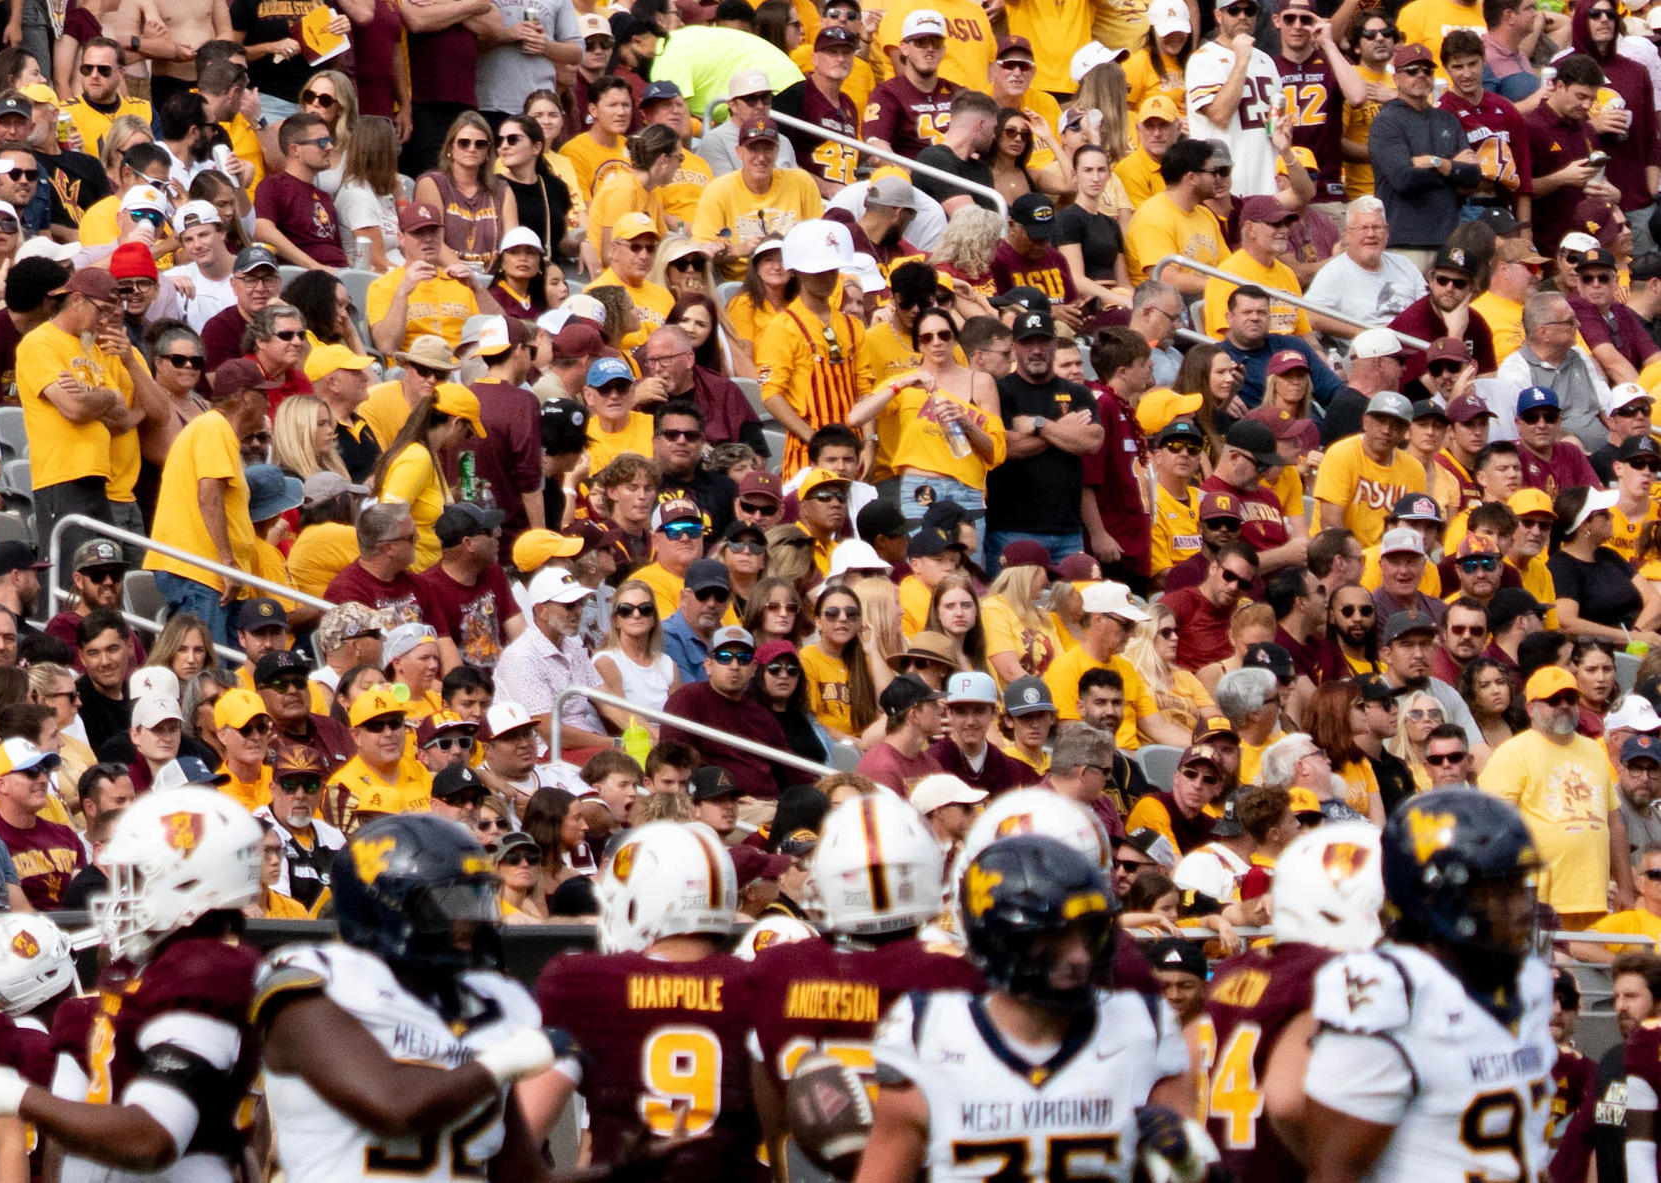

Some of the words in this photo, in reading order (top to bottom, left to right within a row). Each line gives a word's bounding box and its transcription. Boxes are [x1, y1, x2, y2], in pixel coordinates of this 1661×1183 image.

[943, 17, 984, 43] ASU
[1282, 82, 1328, 127] 42
[1352, 477, 1406, 513] ASU
[962, 678, 972, 694] P
[629, 975, 724, 1011] HARPOLE
[787, 980, 879, 1023] ANDERSON
[638, 1024, 722, 1136] 9
[961, 1098, 1012, 1130] WEST
[1018, 1096, 1113, 1130] VIRGINIA
